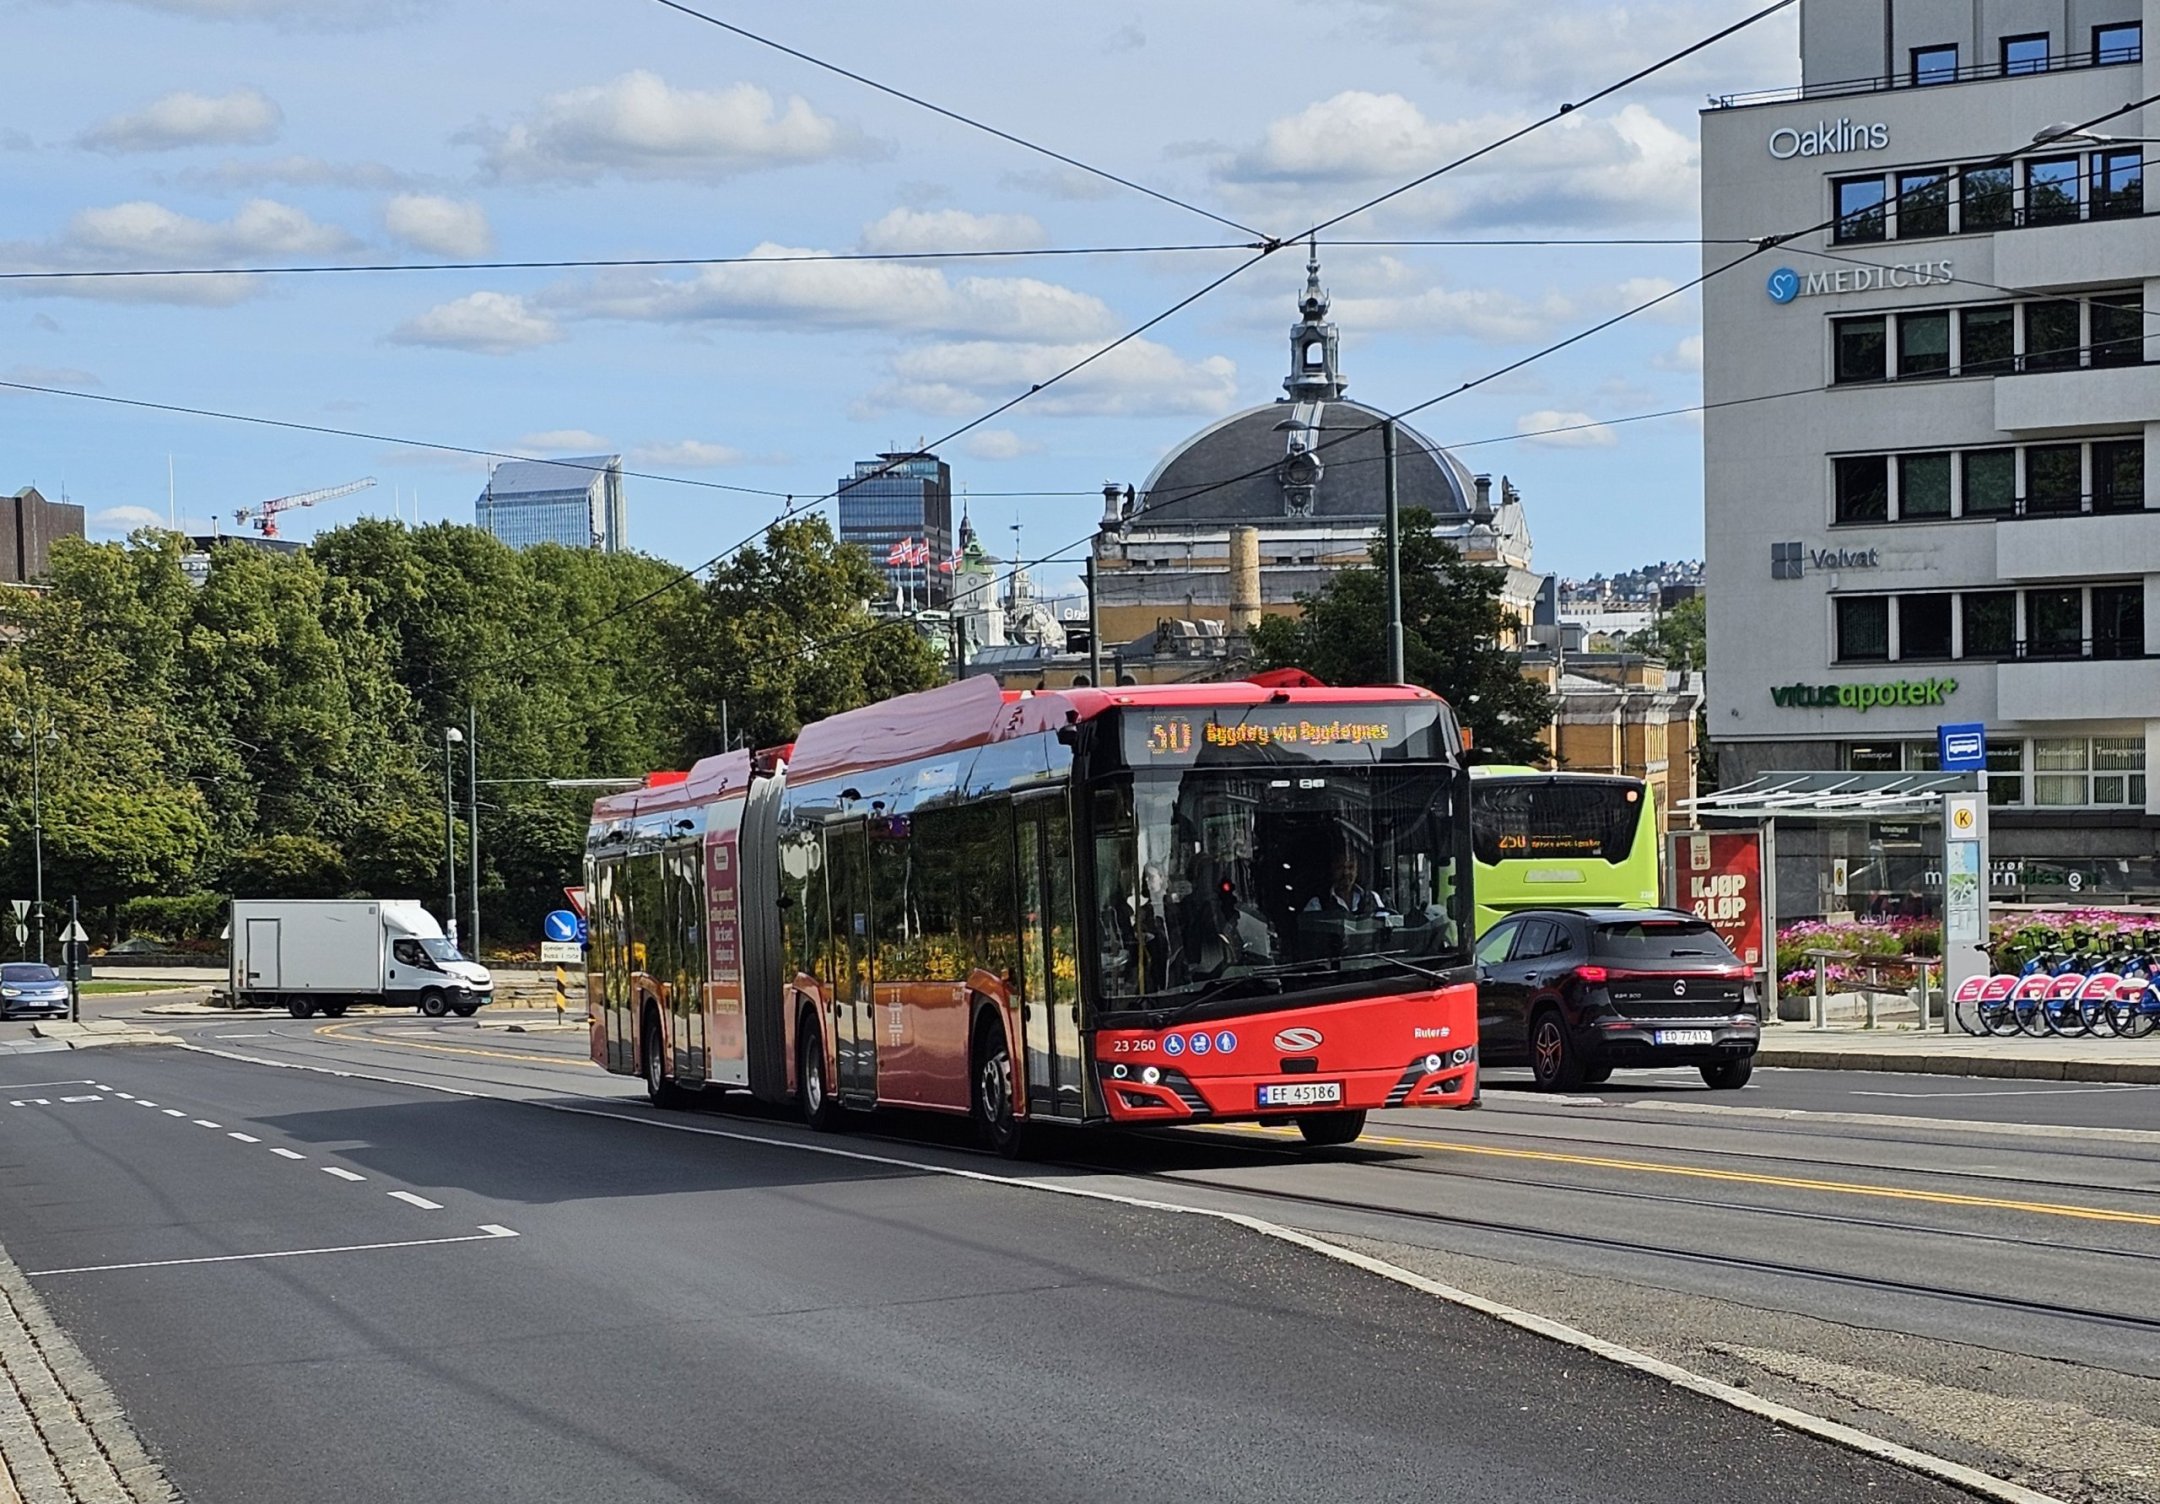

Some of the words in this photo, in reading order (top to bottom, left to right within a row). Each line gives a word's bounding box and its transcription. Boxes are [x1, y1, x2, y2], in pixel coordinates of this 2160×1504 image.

[1769, 117, 1889, 160] Oaklins
[1806, 260, 1954, 296] MEDICUS
[1811, 548, 1878, 569] Volvat
[1273, 722, 1297, 742] via
[1959, 812, 1968, 825] K
[1691, 874, 1746, 897] KJØP
[1692, 897, 1746, 920] &LØP
[1113, 1040, 1129, 1052] 23
[1132, 1039, 1156, 1052] 260
[1681, 1031, 1709, 1041] 77412
[1272, 1088, 1287, 1101] EF
[1294, 1085, 1336, 1100] 45186
